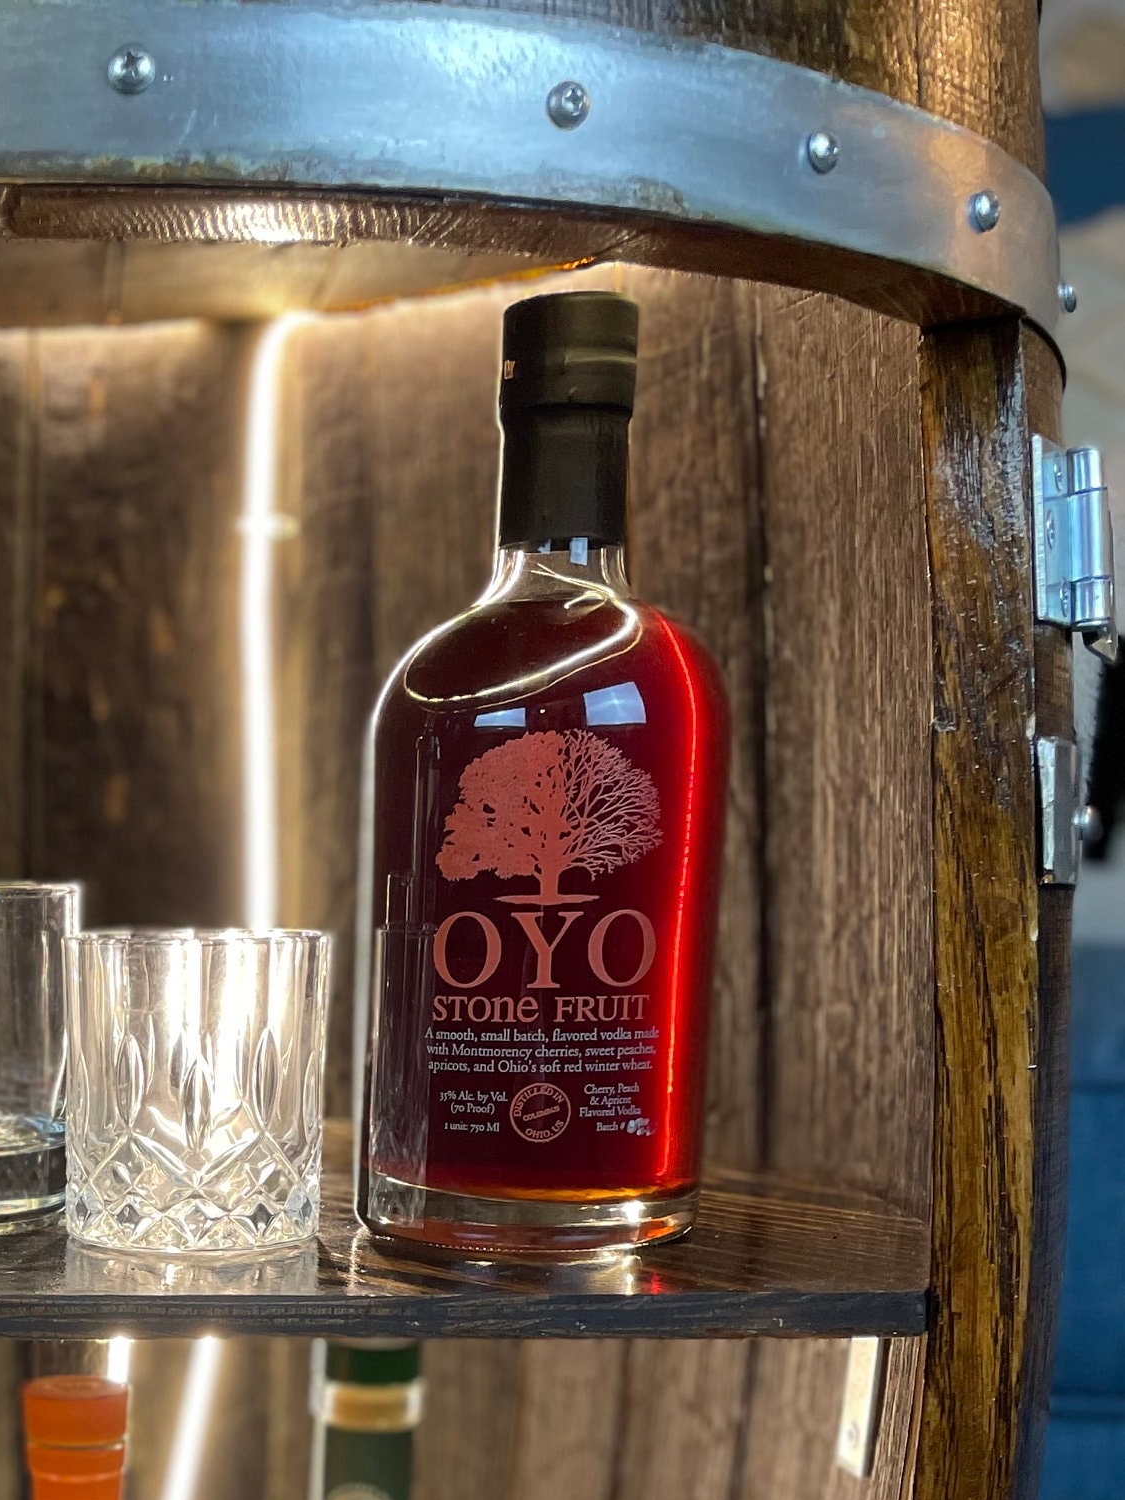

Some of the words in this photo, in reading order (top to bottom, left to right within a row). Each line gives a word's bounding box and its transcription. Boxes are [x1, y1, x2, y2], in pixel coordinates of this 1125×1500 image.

[433, 909, 656, 989] OYO
[554, 994, 650, 1023] FRUIT
[425, 1026, 434, 1039] A
[435, 1027, 477, 1042] smooth,
[480, 1028, 510, 1042] small
[513, 1029, 549, 1043] batch,
[552, 1028, 598, 1042] flavored
[600, 1027, 631, 1041] vodka
[634, 1026, 660, 1040] made
[426, 1042, 449, 1056] with
[451, 1043, 532, 1060] Montmorency
[535, 1044, 582, 1059] cherries,
[585, 1046, 614, 1057] sweet
[617, 1042, 657, 1059] peaches,
[428, 1059, 471, 1073] apricots,
[473, 1059, 495, 1072] and
[497, 1059, 537, 1073] Ohio's
[539, 1059, 562, 1073] soft
[564, 1059, 583, 1072] red
[585, 1060, 620, 1072] winter
[622, 1058, 653, 1071] wheat.
[584, 1083, 615, 1096] Cherry,
[617, 1082, 640, 1093] Peach
[439, 1090, 456, 1102] 35%
[477, 1090, 489, 1104] by
[552, 1091, 565, 1104] IN
[590, 1096, 599, 1105] &
[450, 1102, 465, 1114] (70
[467, 1102, 495, 1115] Proof)
[579, 1106, 615, 1117] Flavored
[617, 1104, 641, 1116] Vodka
[470, 1122, 485, 1133] 750
[596, 1121, 619, 1132] Batch
